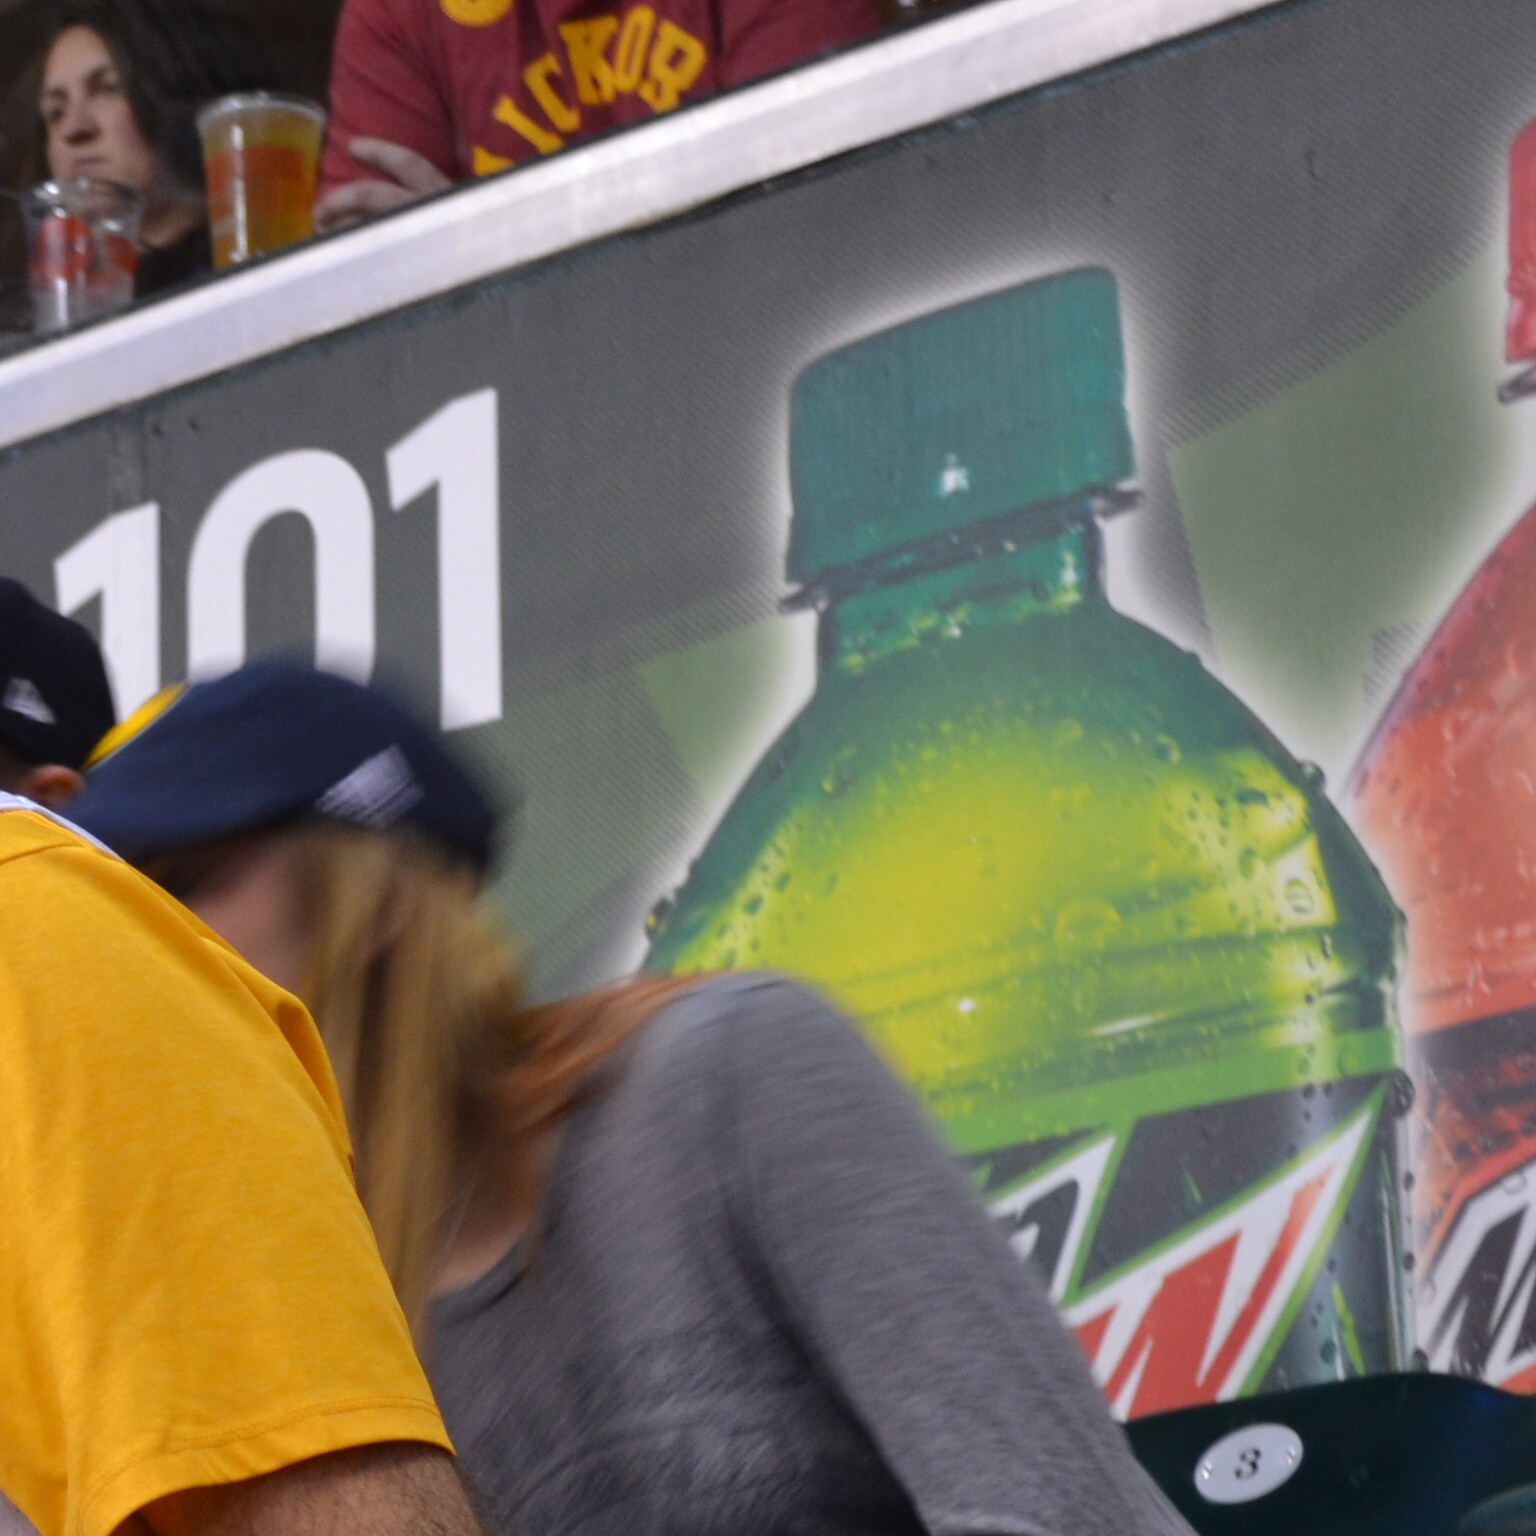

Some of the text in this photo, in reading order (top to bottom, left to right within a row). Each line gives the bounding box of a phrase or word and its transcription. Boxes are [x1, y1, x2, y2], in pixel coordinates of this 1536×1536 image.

[473, 5, 707, 176] ICKOR
[54, 386, 502, 732] 101
[1235, 1447, 1261, 1480] 3
